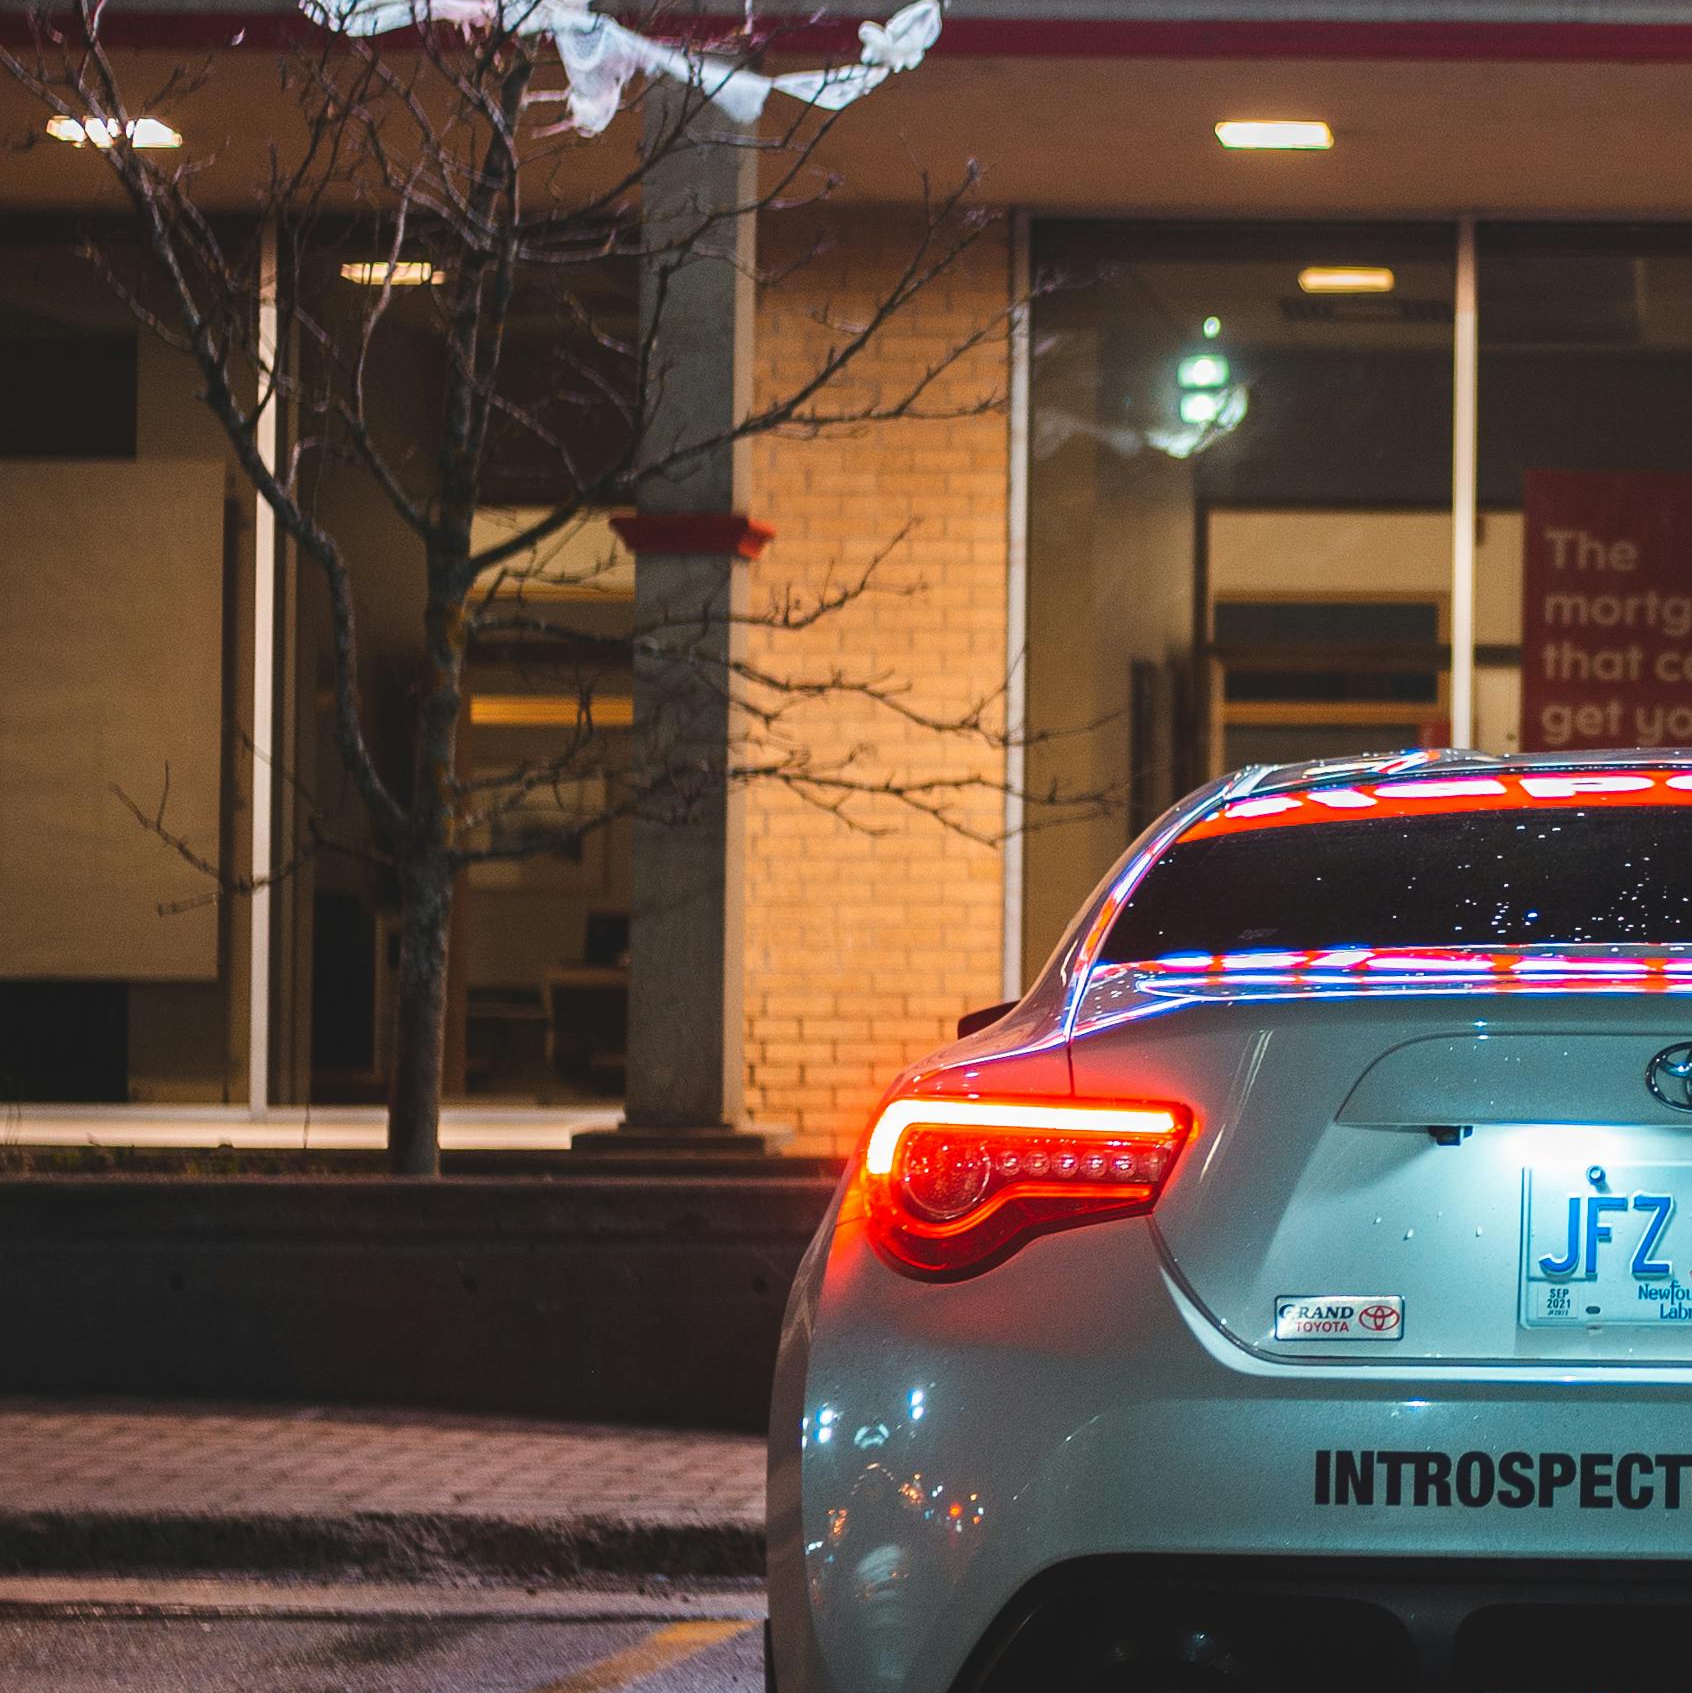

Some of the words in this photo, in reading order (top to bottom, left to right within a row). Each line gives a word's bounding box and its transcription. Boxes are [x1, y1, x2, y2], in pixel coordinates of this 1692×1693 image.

[1545, 530, 1640, 572] The
[1542, 642, 1645, 682] that
[1541, 698, 1624, 746] get
[1539, 1195, 1673, 1278] JFZ
[1547, 1298, 1571, 1309] 2021
[1550, 1288, 1569, 1298] SEP
[1296, 1321, 1350, 1333] TOYOTA
